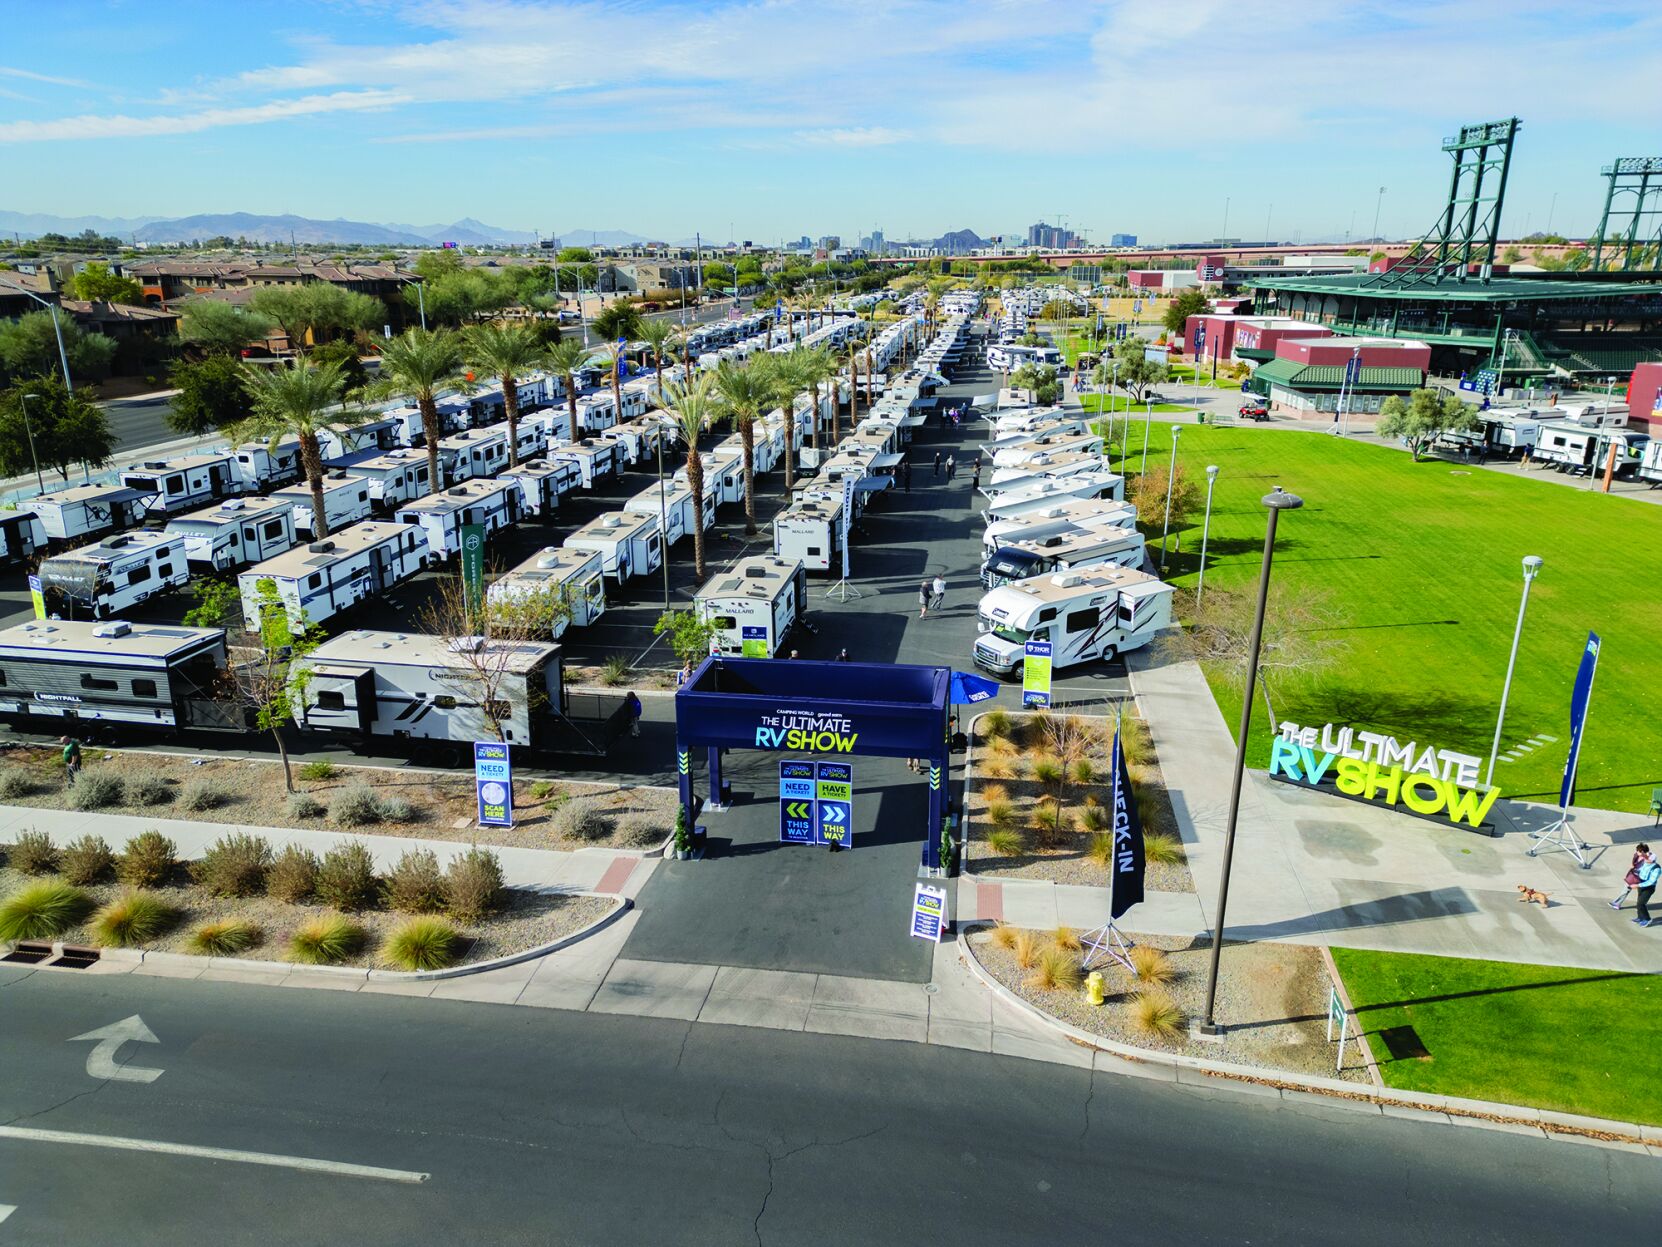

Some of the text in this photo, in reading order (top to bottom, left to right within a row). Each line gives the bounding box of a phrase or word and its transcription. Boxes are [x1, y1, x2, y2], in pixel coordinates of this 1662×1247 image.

[1033, 646, 1050, 654] THOR
[39, 693, 82, 702] NIGHTFALL
[761, 716, 851, 733] THE ULTIMATE
[755, 727, 859, 752] RV SHOW
[1279, 721, 1482, 788] THE ULTIMATE
[481, 764, 504, 773] NEED
[1269, 734, 1502, 828] RV SHOW
[785, 783, 810, 791] NEED
[822, 785, 847, 793] HAVE
[484, 804, 505, 812] SCAN
[787, 820, 809, 829] THIS
[823, 824, 846, 833] THIS
[787, 828, 808, 836] WAY
[823, 832, 845, 841] WAY
